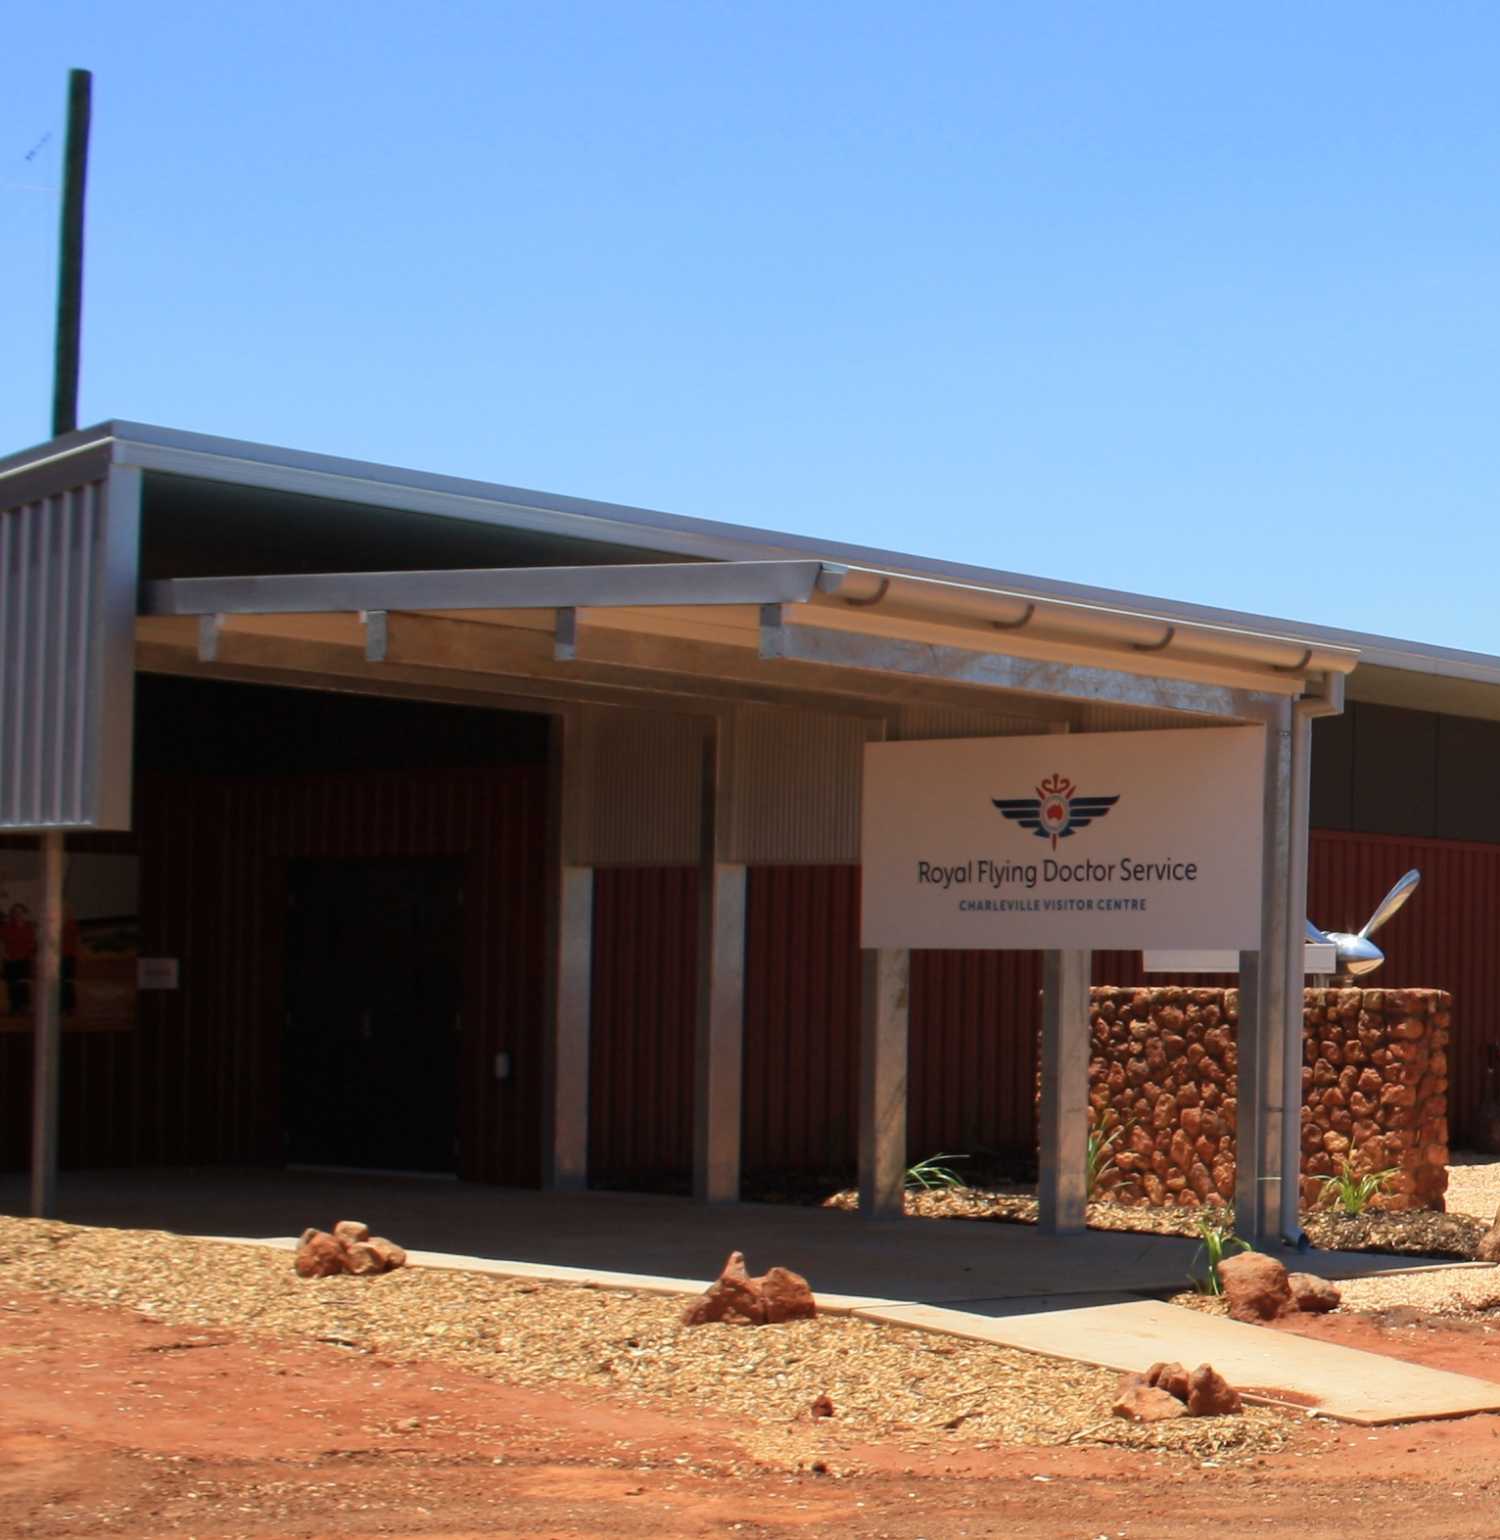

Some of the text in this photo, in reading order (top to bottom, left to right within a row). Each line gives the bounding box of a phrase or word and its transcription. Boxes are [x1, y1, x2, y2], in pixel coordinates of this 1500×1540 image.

[918, 857, 1198, 889] Royal Flying Doctor Service
[958, 898, 1147, 912] CHARLEVILLE VISITOR CENTRE
